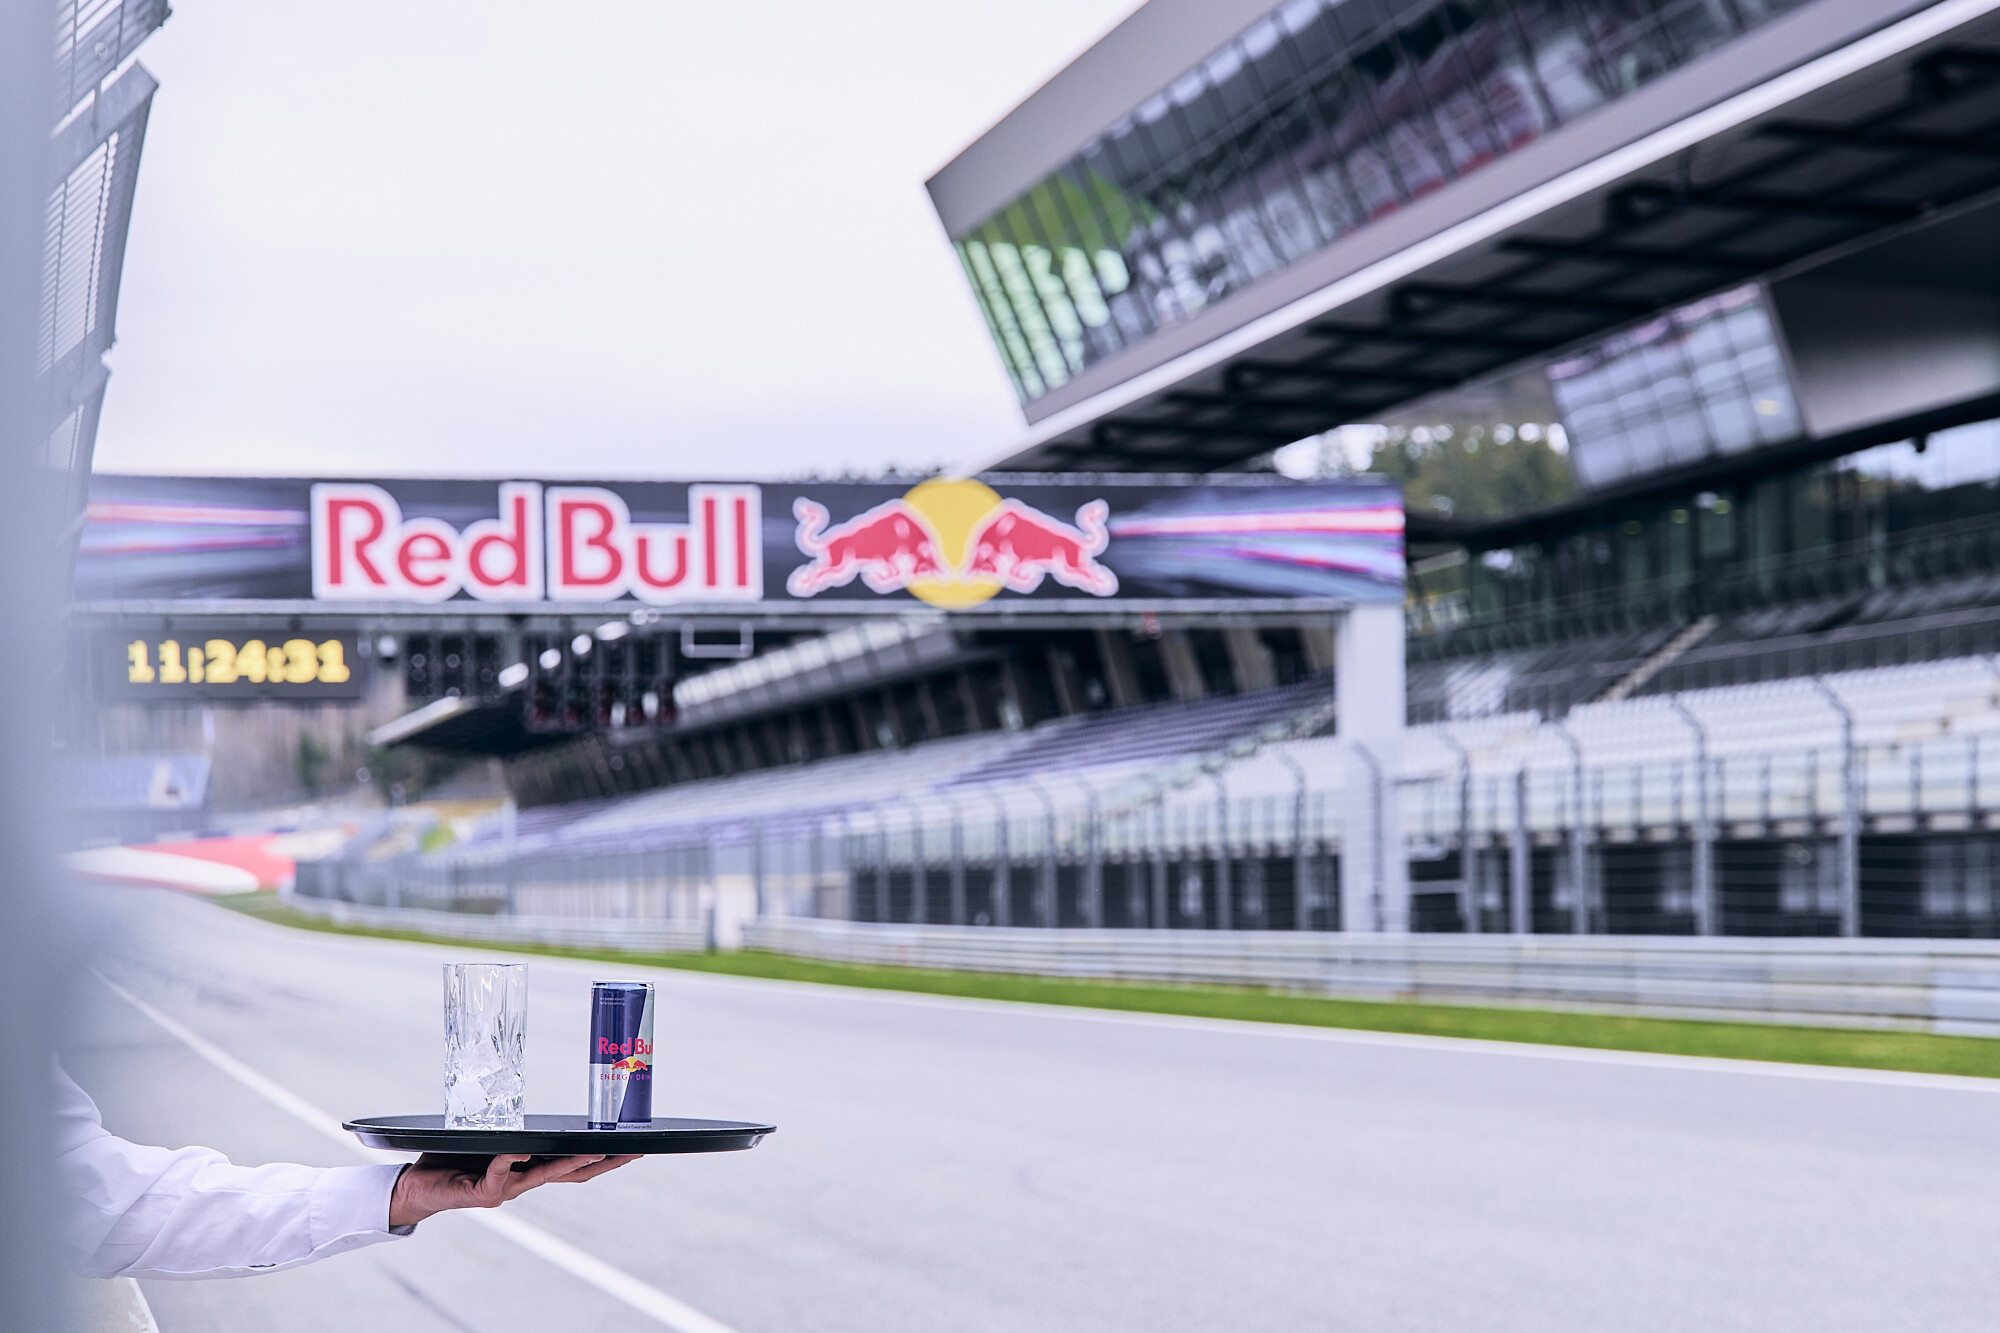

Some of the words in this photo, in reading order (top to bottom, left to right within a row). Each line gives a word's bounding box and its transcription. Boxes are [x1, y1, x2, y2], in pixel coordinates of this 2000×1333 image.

[325, 494, 529, 589] Red
[558, 495, 751, 591] Bull
[128, 639, 350, 683] 11:24:31
[599, 1037, 632, 1054] Red
